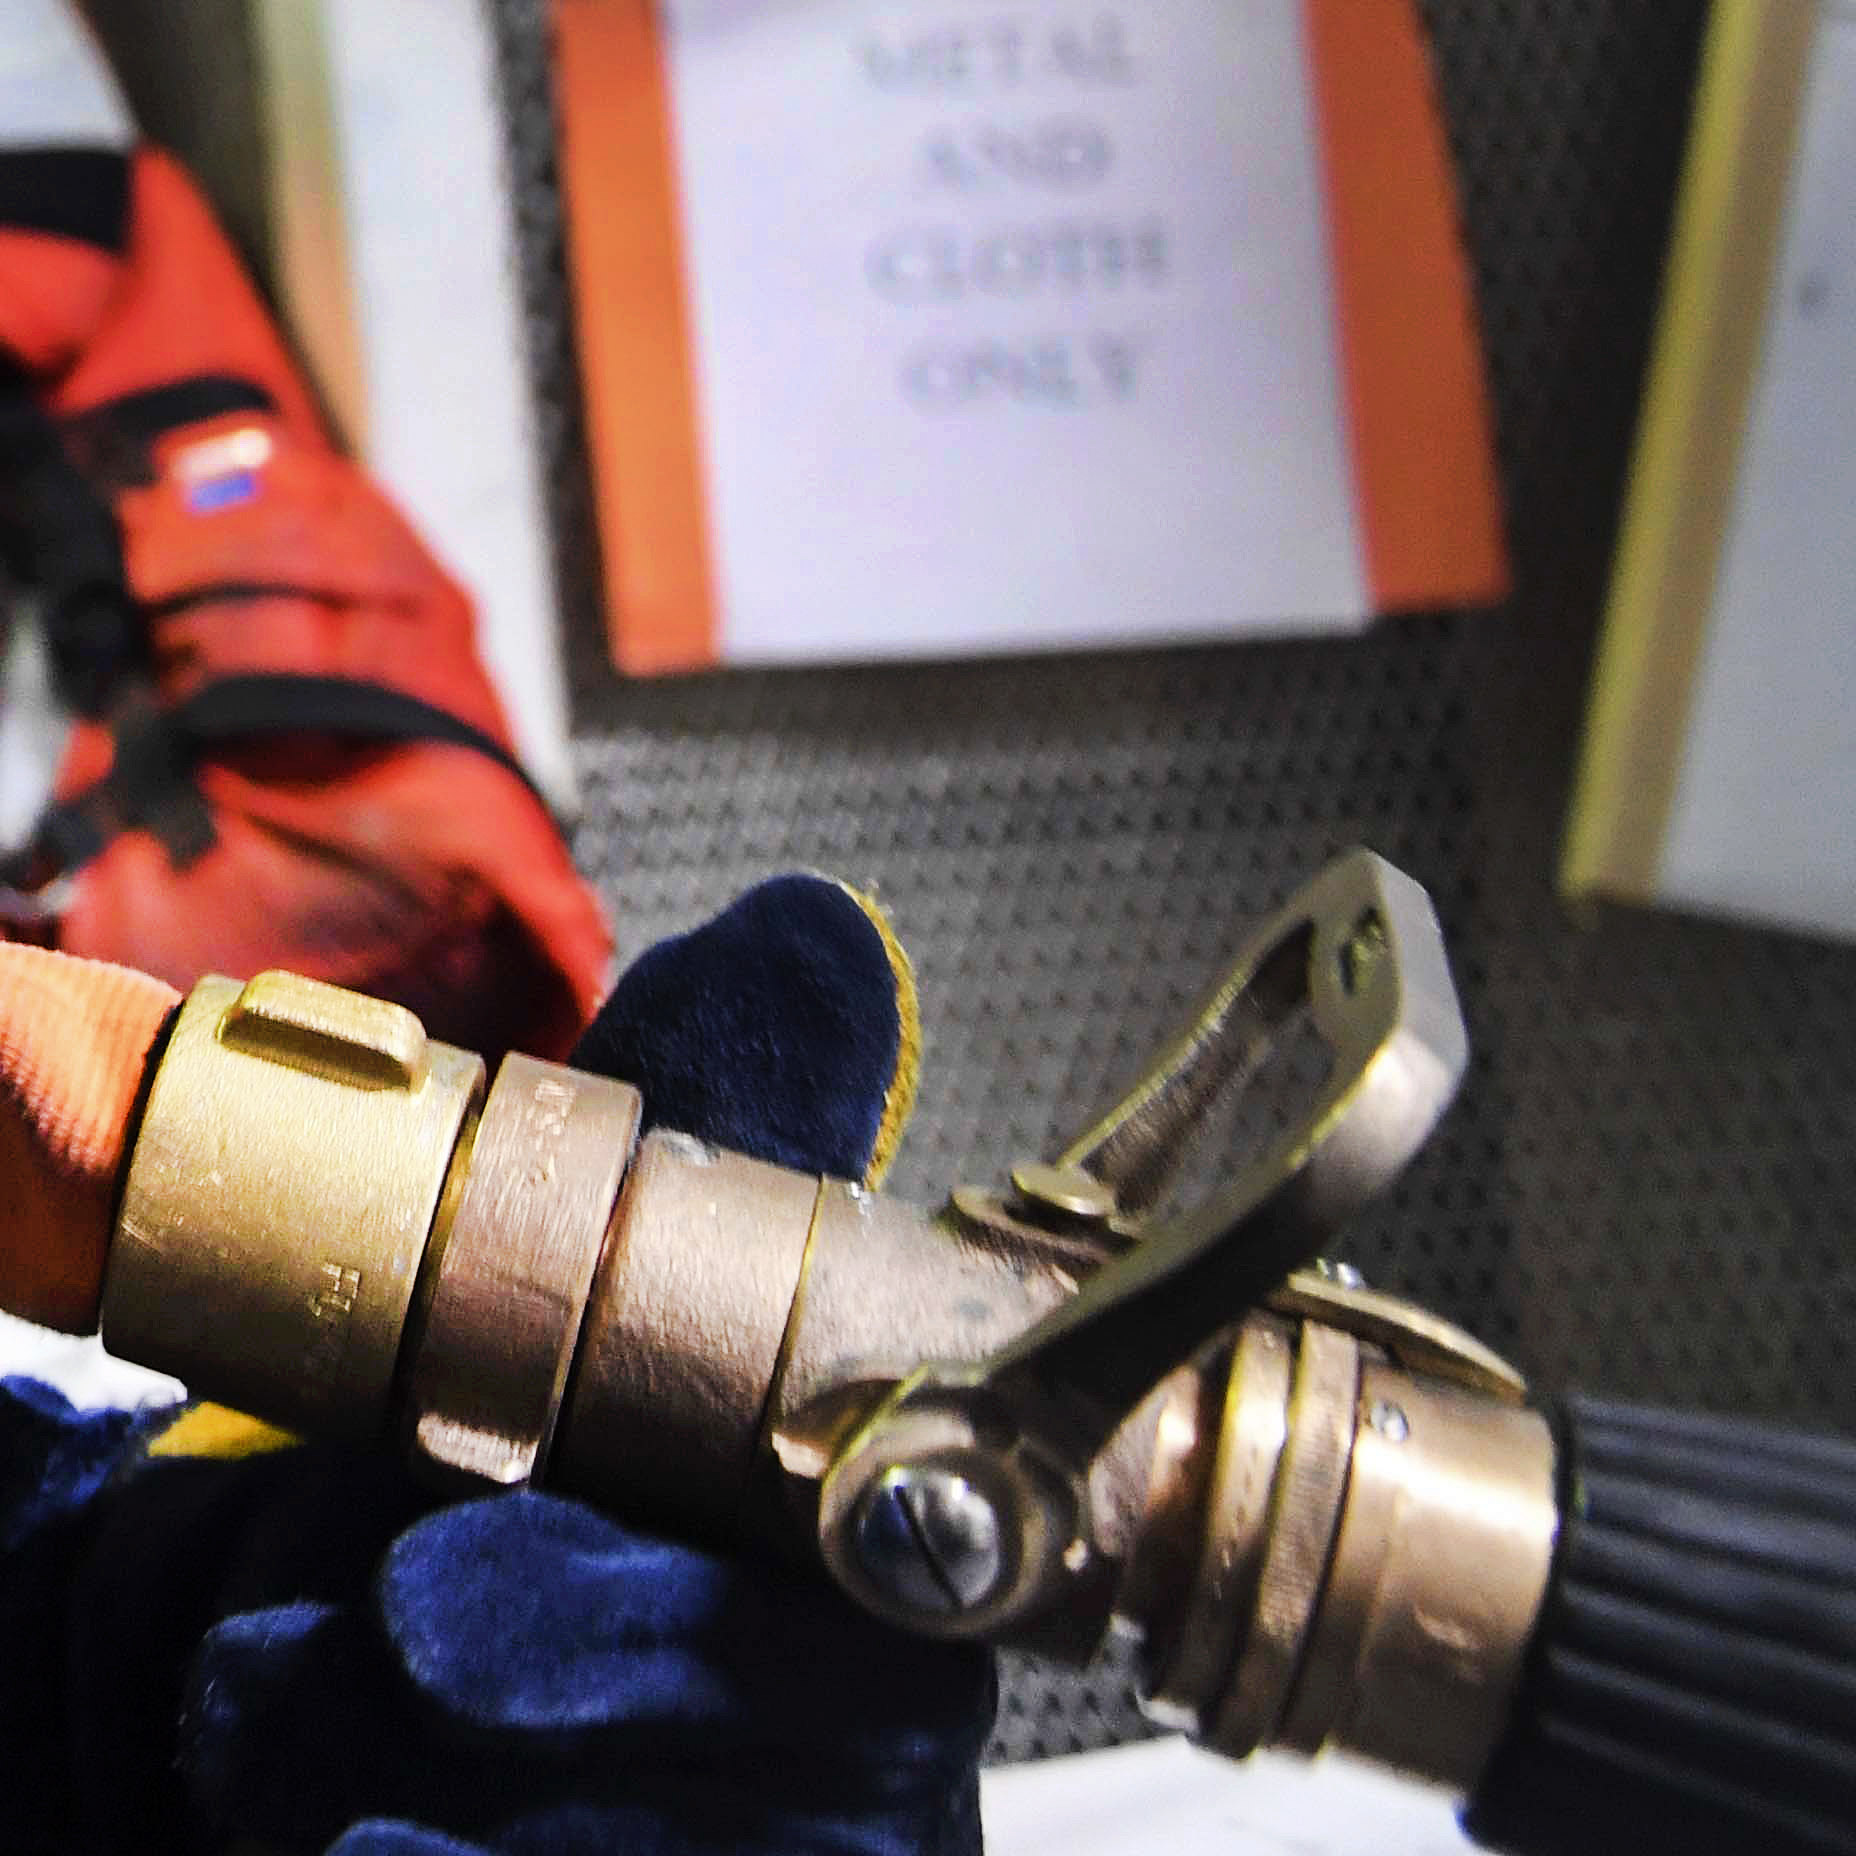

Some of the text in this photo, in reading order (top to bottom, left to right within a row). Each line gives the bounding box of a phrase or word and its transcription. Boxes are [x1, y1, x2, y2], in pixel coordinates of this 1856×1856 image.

[916, 115, 1114, 199] AND
[864, 216, 1174, 306] CLOTH
[898, 331, 1156, 420] ONLY
